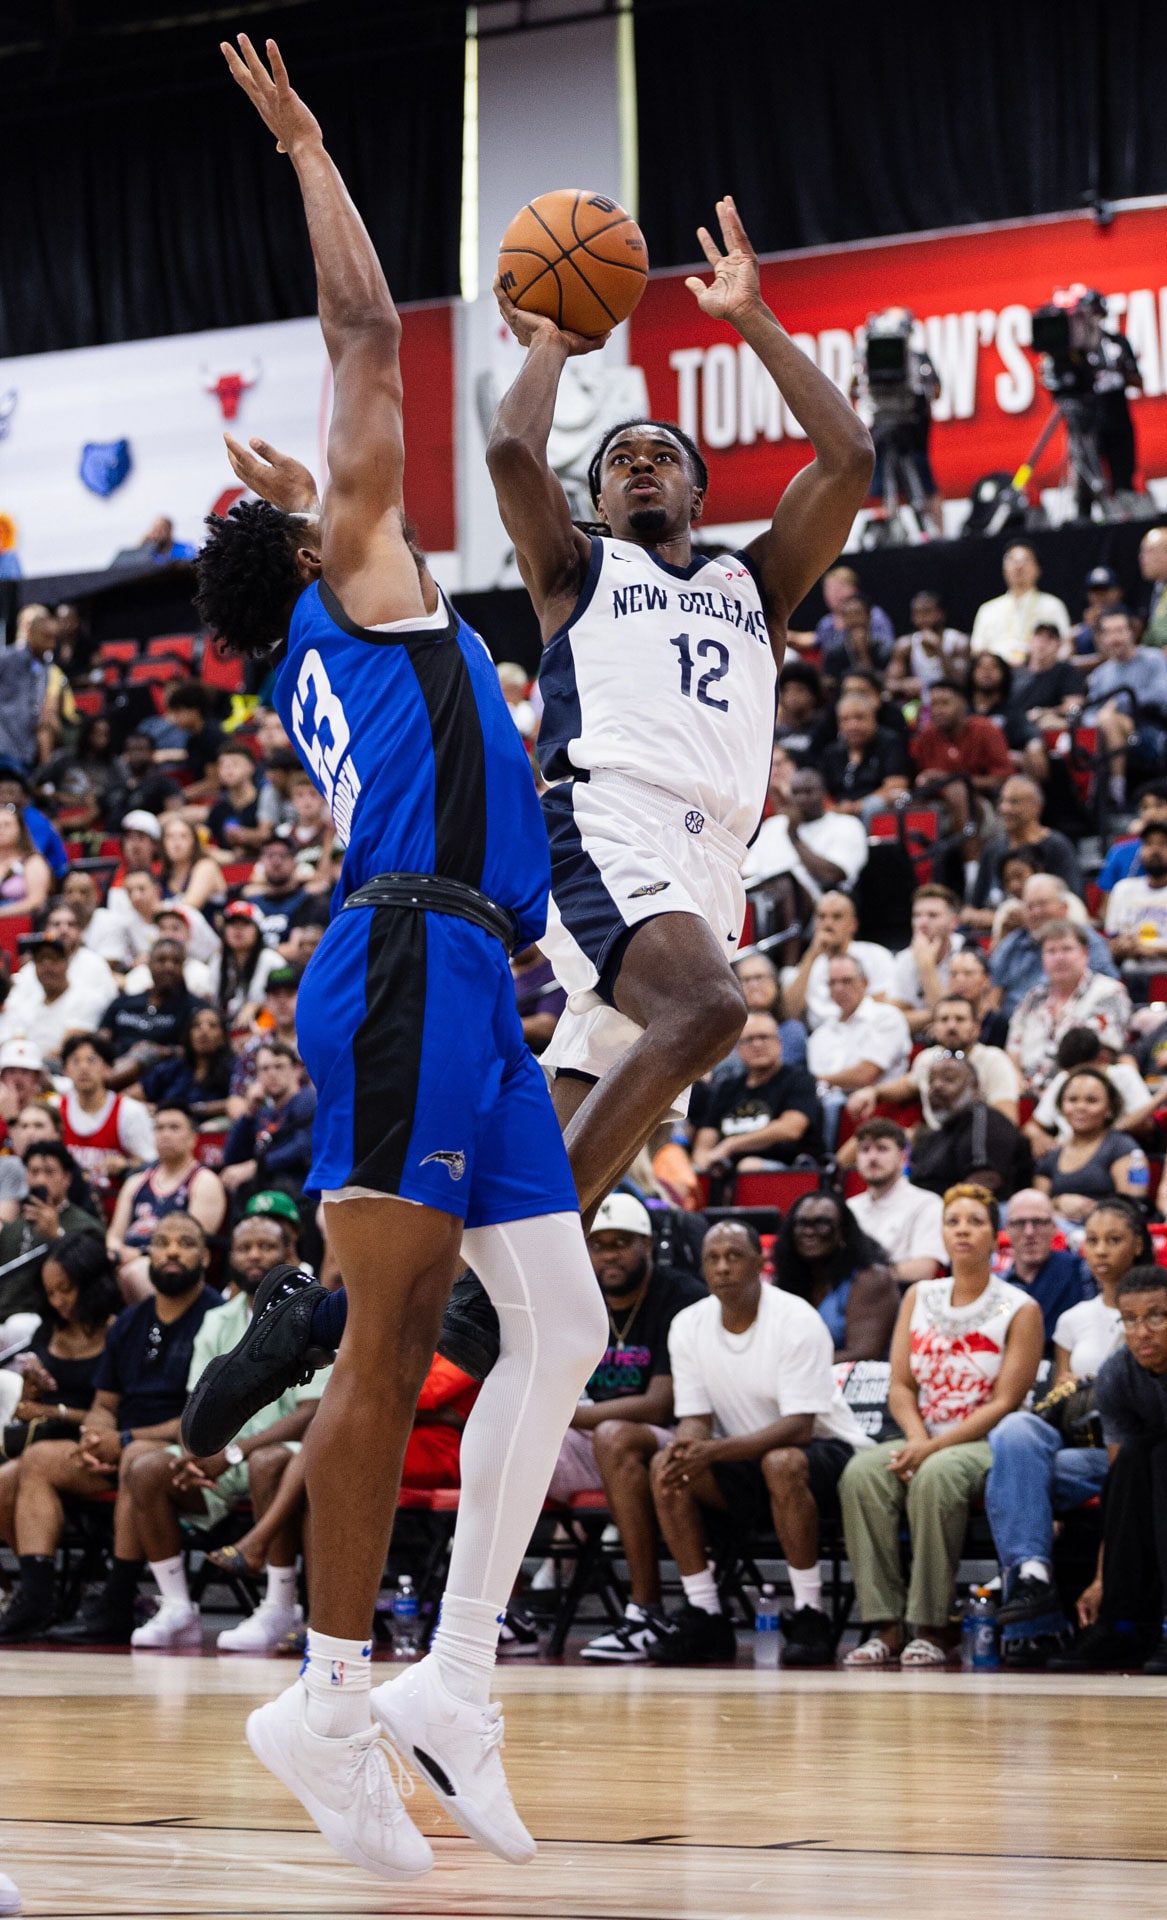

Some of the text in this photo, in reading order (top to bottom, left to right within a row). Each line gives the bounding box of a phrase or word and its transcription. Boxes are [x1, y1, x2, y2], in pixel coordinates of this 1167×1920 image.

[613, 584, 768, 646] NEW ORLEANS
[670, 633, 730, 712] 12
